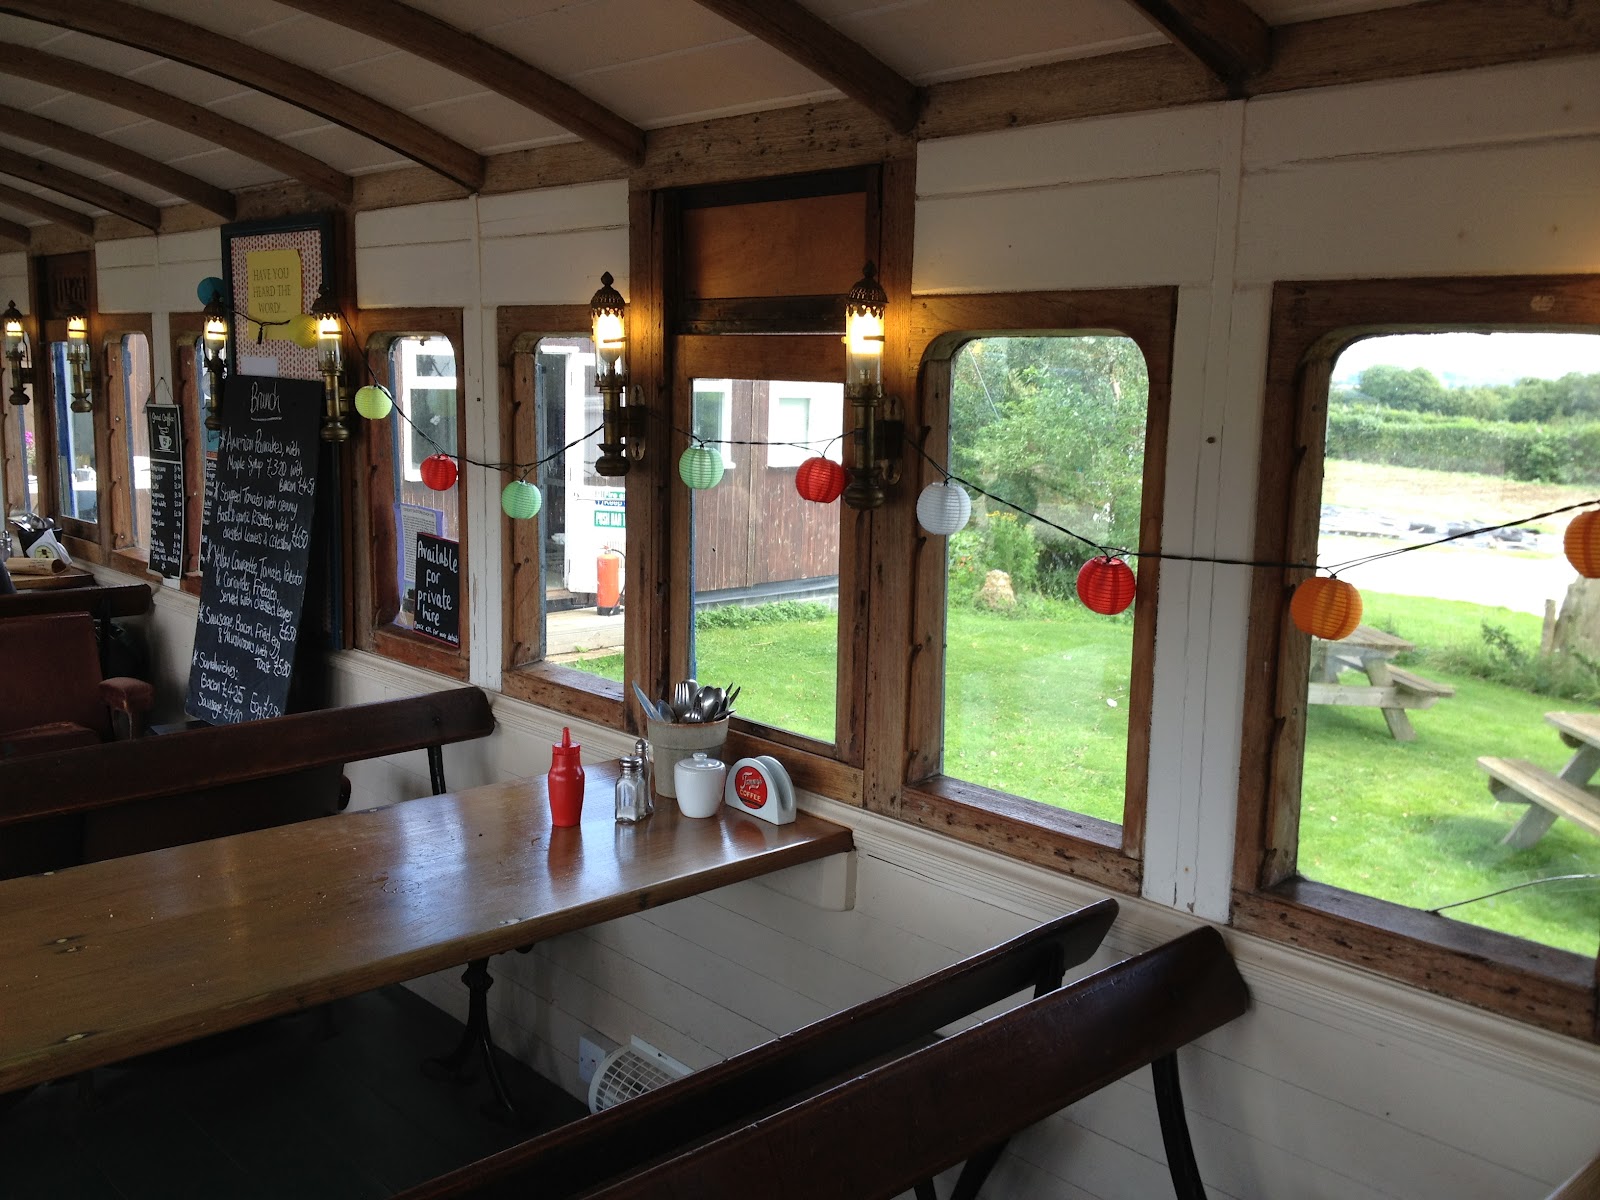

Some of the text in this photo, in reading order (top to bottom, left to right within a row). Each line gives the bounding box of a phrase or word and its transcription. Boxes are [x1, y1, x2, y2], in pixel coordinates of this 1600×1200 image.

[254, 268, 289, 281] HAVE YOU
[253, 284, 291, 298] HEARD THE
[250, 381, 281, 414] Brunch
[226, 426, 254, 452] American
[286, 440, 300, 457] with
[227, 455, 245, 479] Maple
[248, 454, 264, 478] Syrup
[290, 460, 303, 477] with
[279, 478, 296, 492] Bacon
[242, 486, 263, 507] Tomato
[264, 494, 276, 510] with
[275, 516, 289, 532] with
[418, 540, 458, 573] Available
[283, 560, 302, 586] Potato
[426, 569, 440, 587] for
[240, 590, 252, 607] with
[417, 588, 452, 610] private
[422, 604, 440, 626] hire
[255, 622, 272, 642] Fried
[269, 636, 280, 660] egg
[255, 644, 268, 658] with
[254, 658, 271, 674] Toast
[200, 672, 220, 693] Bacon
[198, 692, 222, 719] Sausage
[250, 692, 261, 720] Egg
[740, 788, 762, 802] COFFEE
